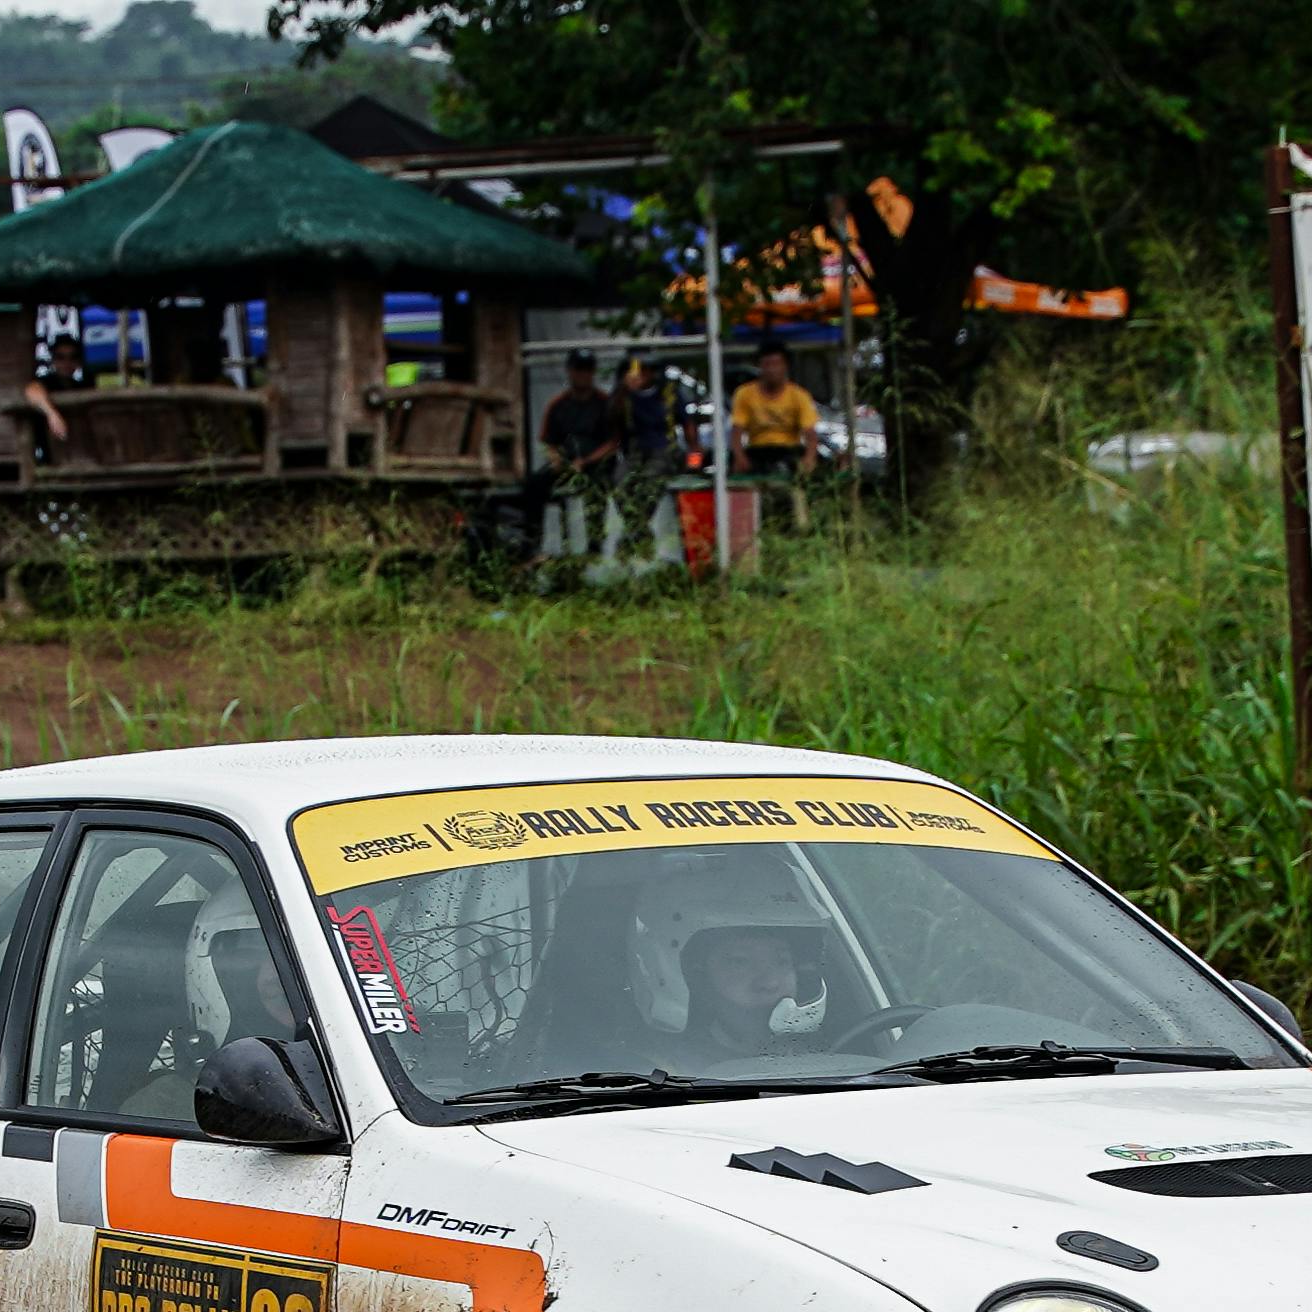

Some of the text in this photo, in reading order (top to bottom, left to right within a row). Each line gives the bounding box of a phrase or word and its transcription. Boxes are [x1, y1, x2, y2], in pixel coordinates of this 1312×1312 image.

[518, 799, 900, 839] RALLY RACERS CLUB
[339, 831, 418, 855] IMPRINT
[343, 840, 433, 863] CUSTOMS
[114, 1268, 133, 1287] THE
